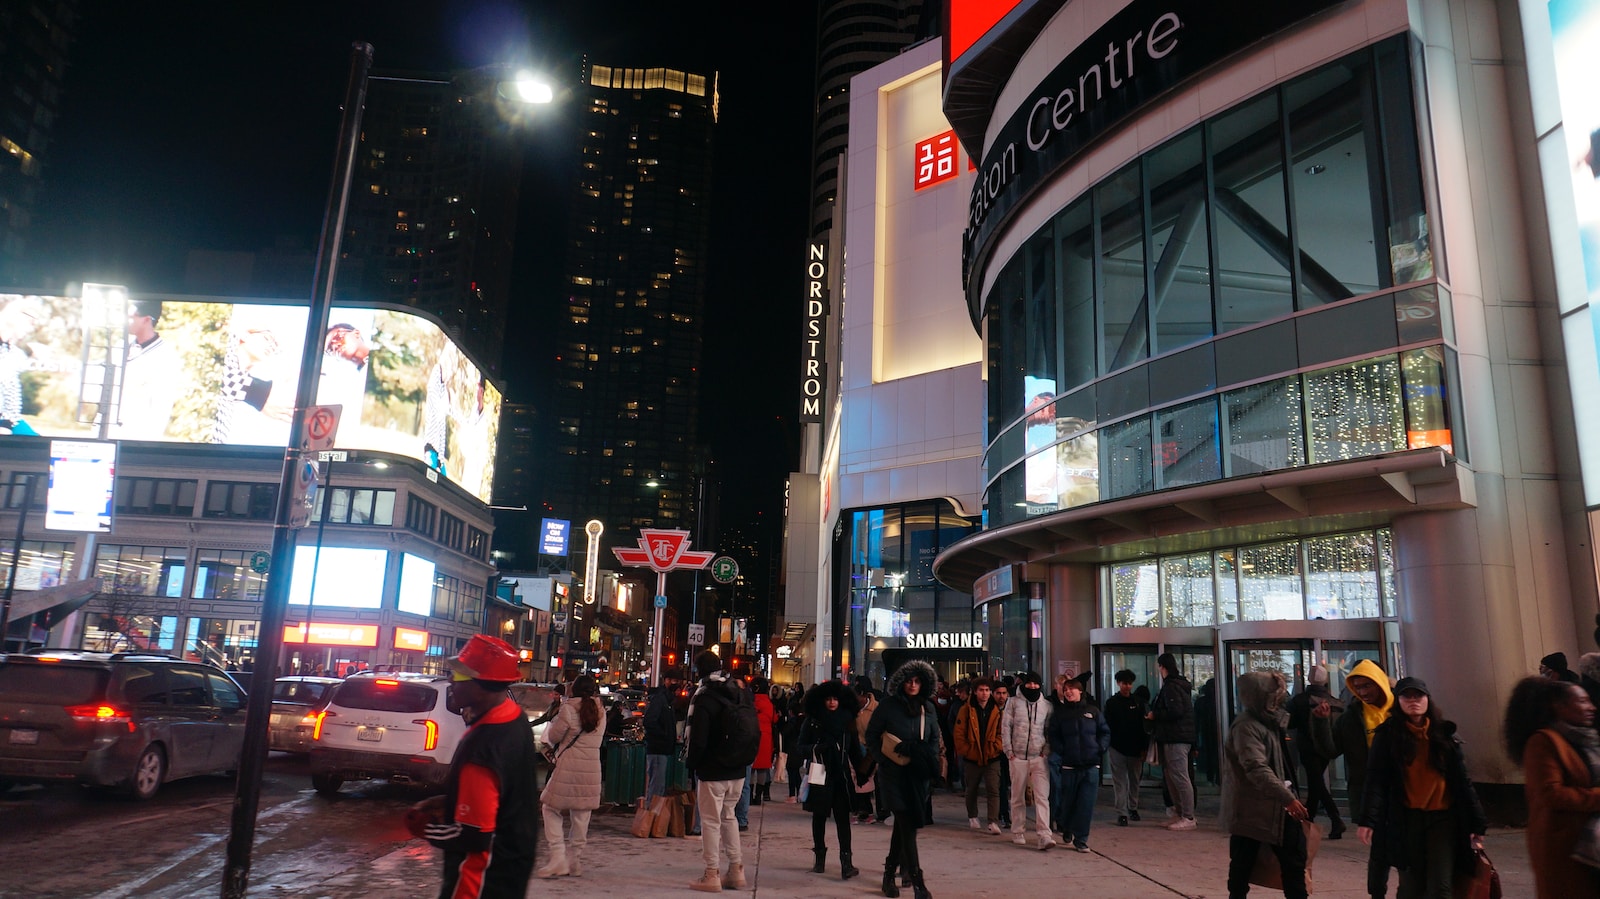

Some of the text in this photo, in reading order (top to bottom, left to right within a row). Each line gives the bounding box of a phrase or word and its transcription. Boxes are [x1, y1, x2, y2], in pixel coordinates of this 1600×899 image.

[1026, 12, 1183, 151] Centre
[803, 244, 825, 416] NORDSTROM
[720, 563, 731, 574] P
[689, 632, 703, 643] 40
[906, 632, 983, 648] SAMSUNG
